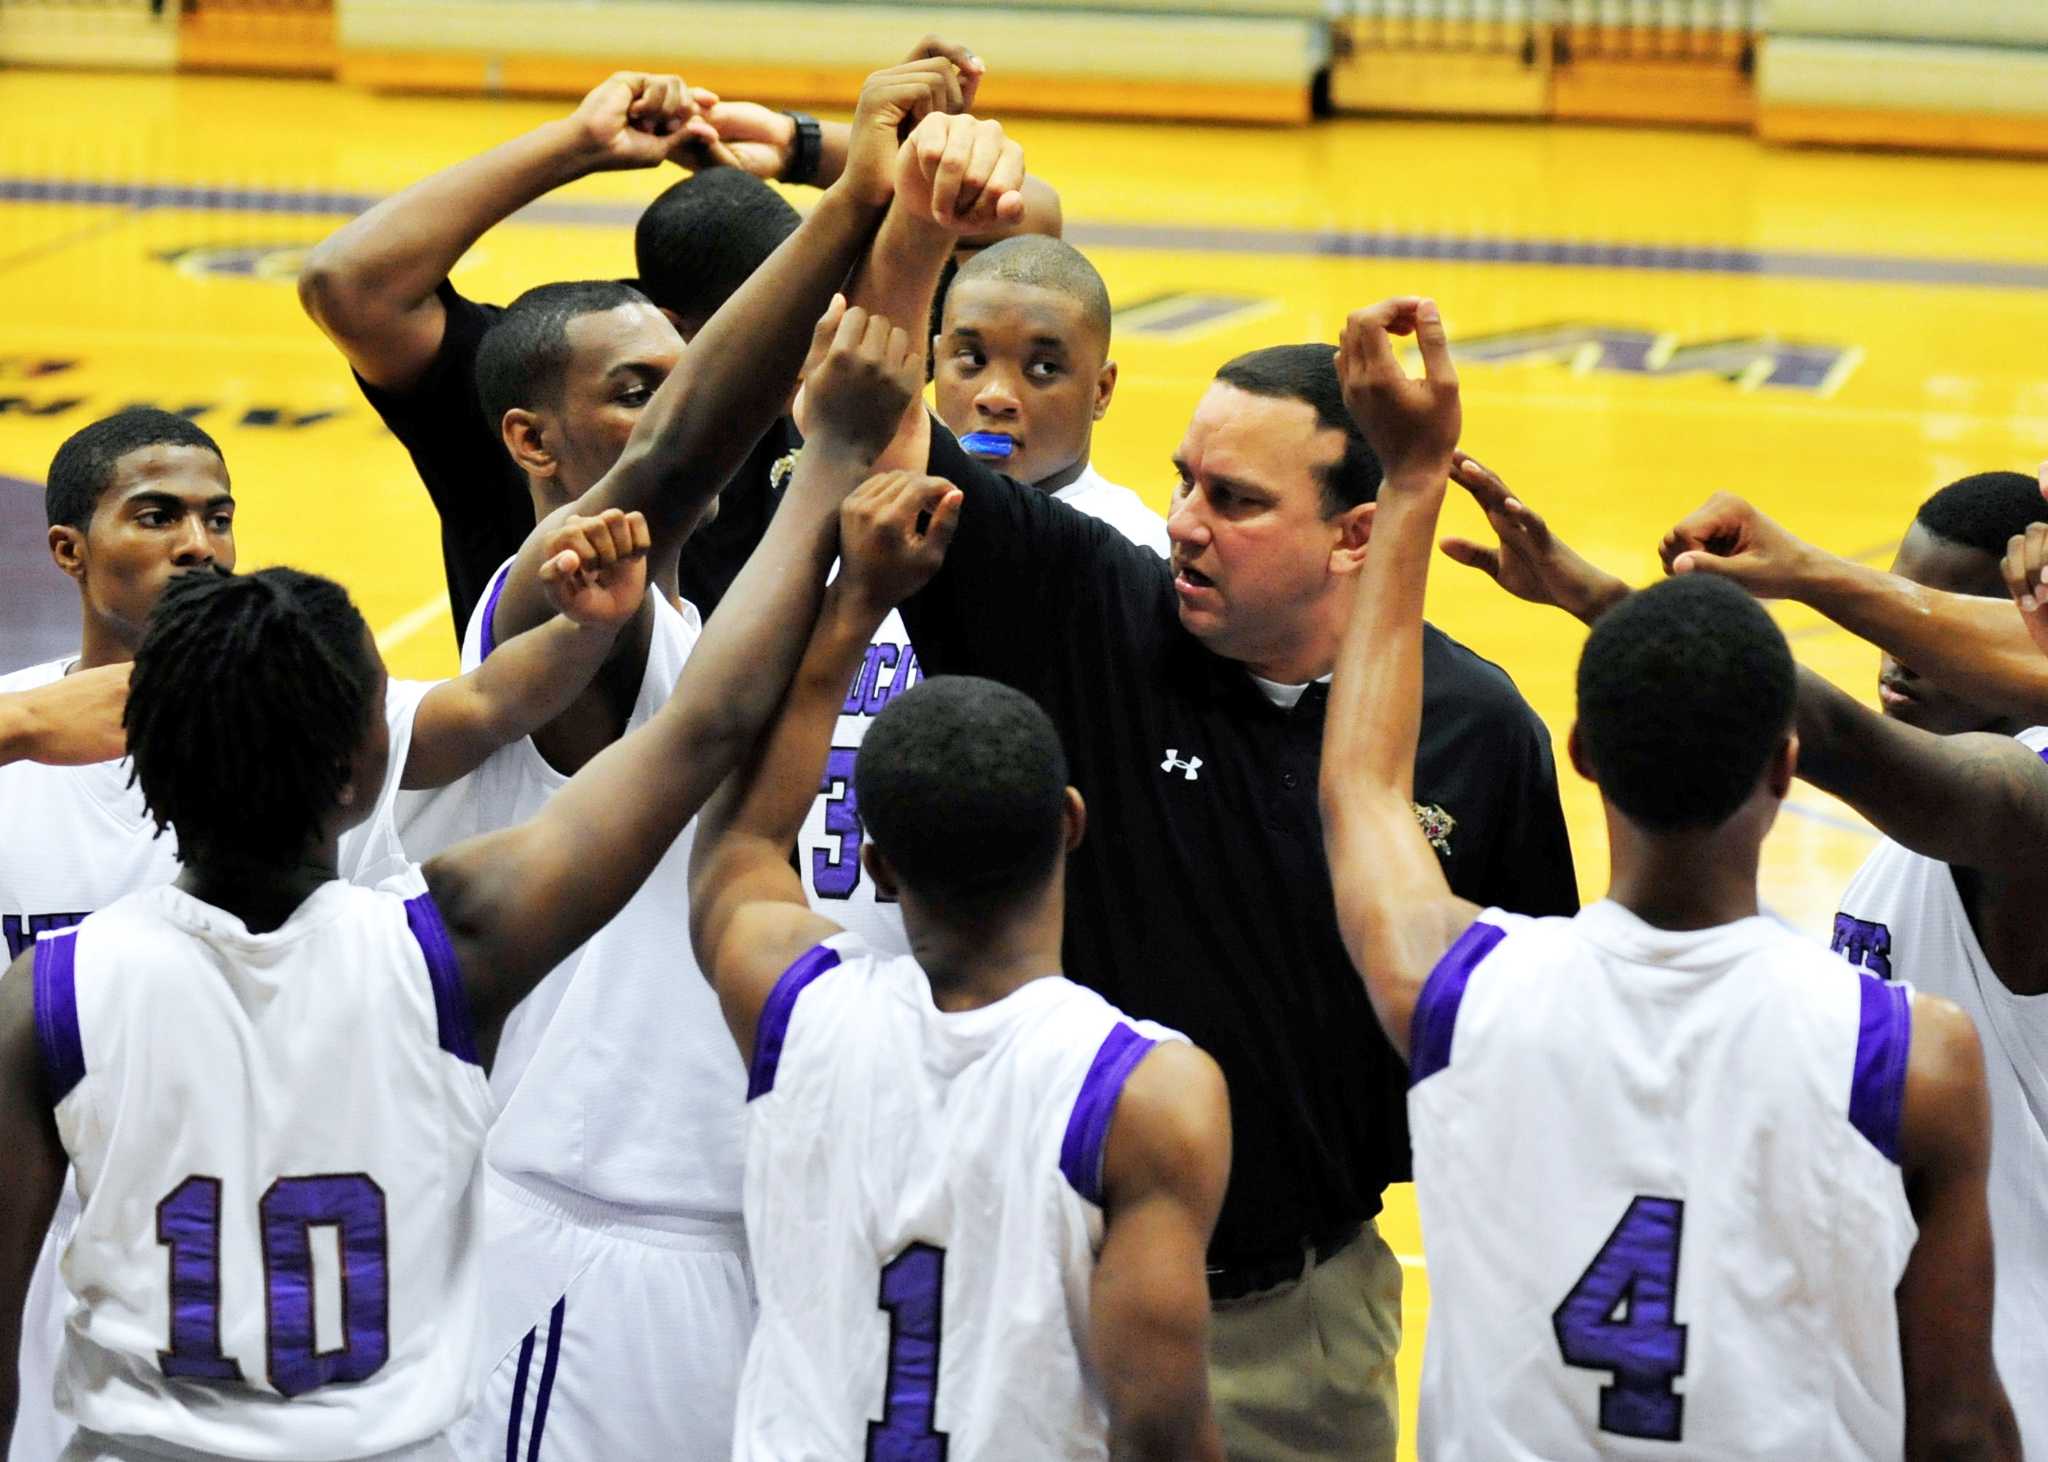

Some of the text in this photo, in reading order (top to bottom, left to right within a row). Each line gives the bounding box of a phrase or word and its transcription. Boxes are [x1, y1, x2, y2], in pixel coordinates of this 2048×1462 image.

[156, 1172, 390, 1398] 10
[865, 1240, 949, 1462] 1
[1552, 1195, 1688, 1441] 4
